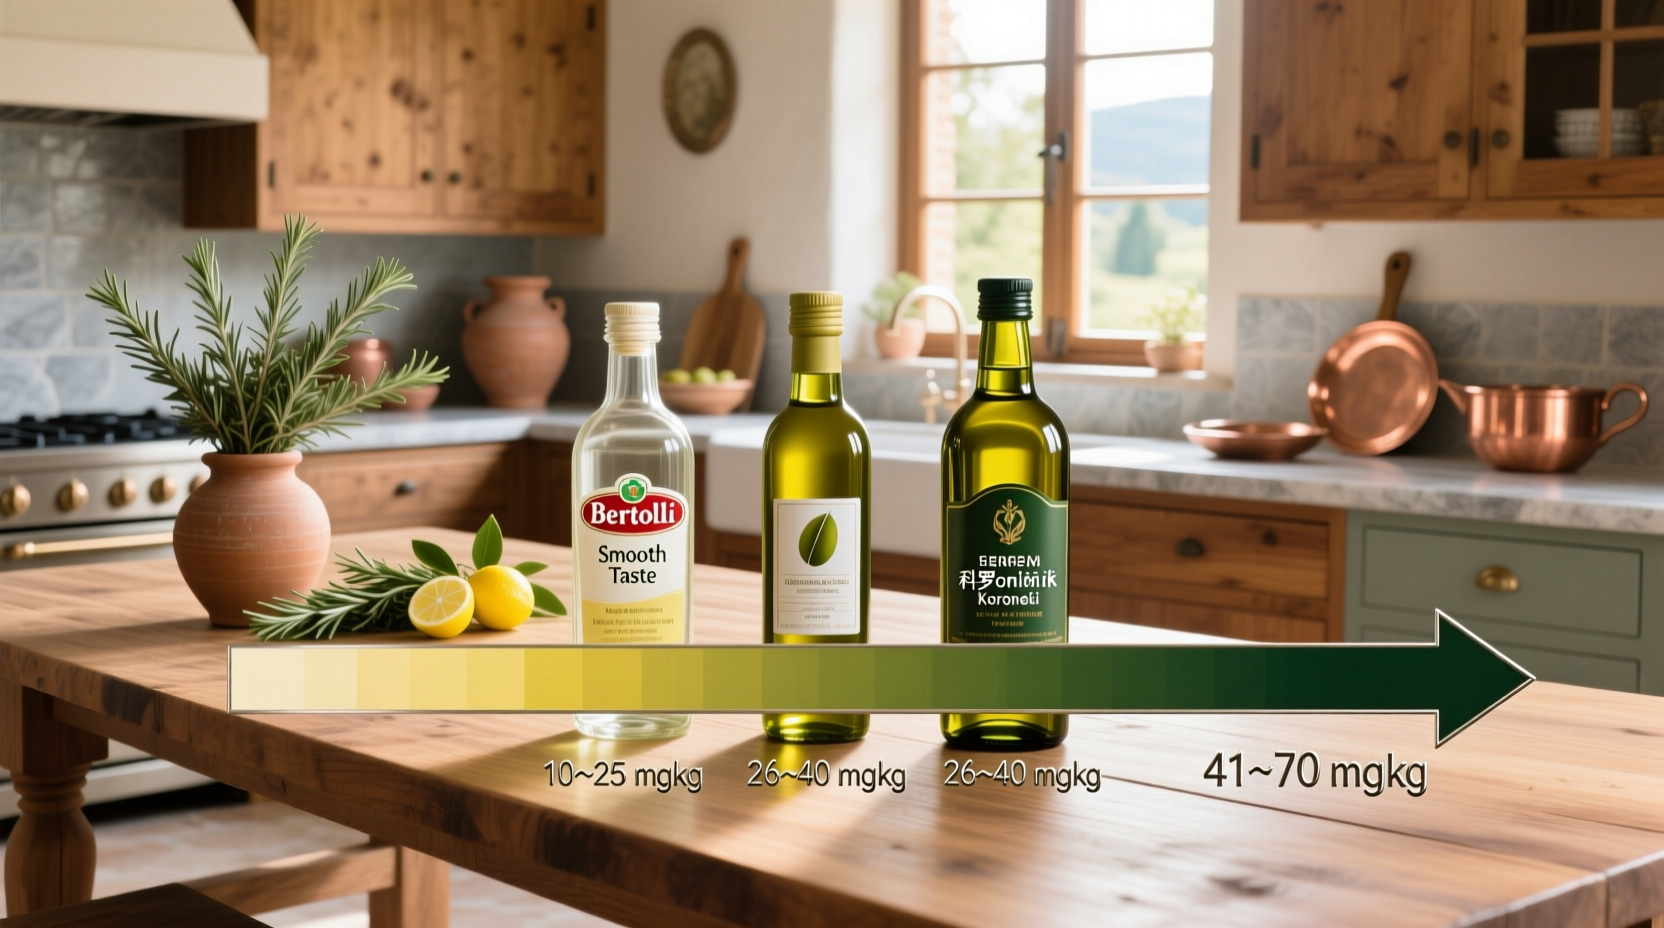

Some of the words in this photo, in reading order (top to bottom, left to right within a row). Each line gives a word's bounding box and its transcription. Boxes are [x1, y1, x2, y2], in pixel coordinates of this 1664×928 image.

[590, 501, 676, 525] Bertolli
[598, 544, 667, 563] Smooth
[609, 566, 657, 584] Taste
